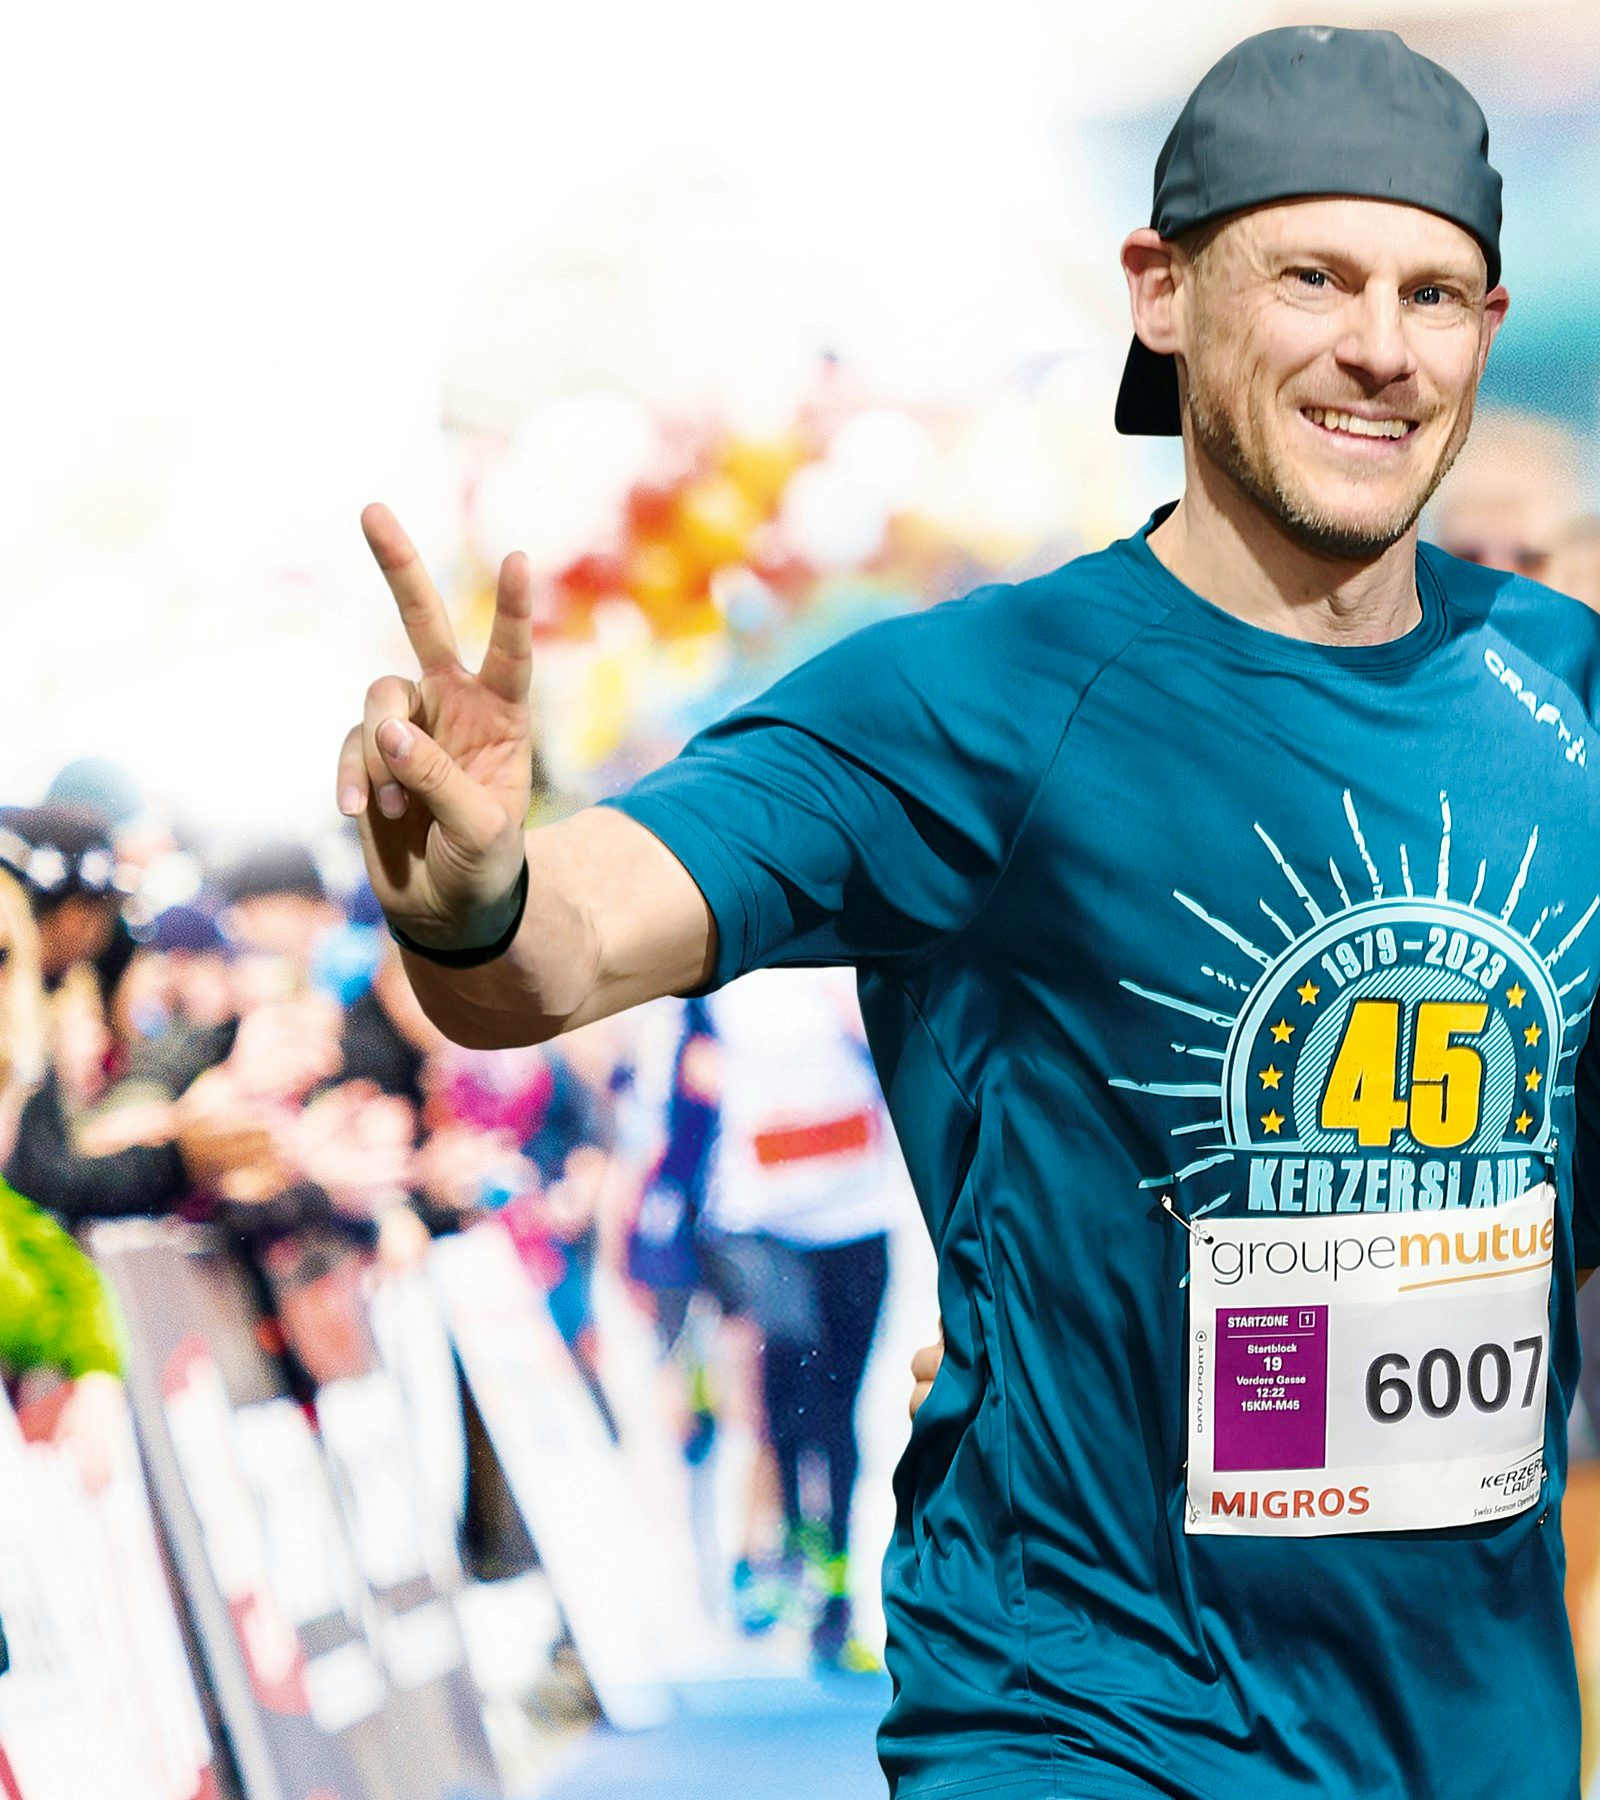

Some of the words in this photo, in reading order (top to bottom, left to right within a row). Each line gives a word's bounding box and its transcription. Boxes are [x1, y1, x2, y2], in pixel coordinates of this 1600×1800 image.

[1321, 999, 1490, 1149] 45
[1211, 1217, 1553, 1286] groupemutue
[1227, 1315, 1289, 1328] STARTZONE
[1247, 1343, 1297, 1354] Startblock
[1263, 1356, 1283, 1372] 19
[1236, 1376, 1274, 1386] Vordere
[1276, 1375, 1307, 1385] Gasse
[1364, 1334, 1543, 1426] 6007
[1256, 1387, 1286, 1398] 12:22
[1241, 1400, 1300, 1411] 15KM-M45
[1480, 1458, 1543, 1489] KERZER
[1503, 1474, 1535, 1496] LAUF
[1211, 1486, 1370, 1519] MIGROS
[1473, 1506, 1492, 1518] Swiss
[1494, 1502, 1516, 1513] Season
